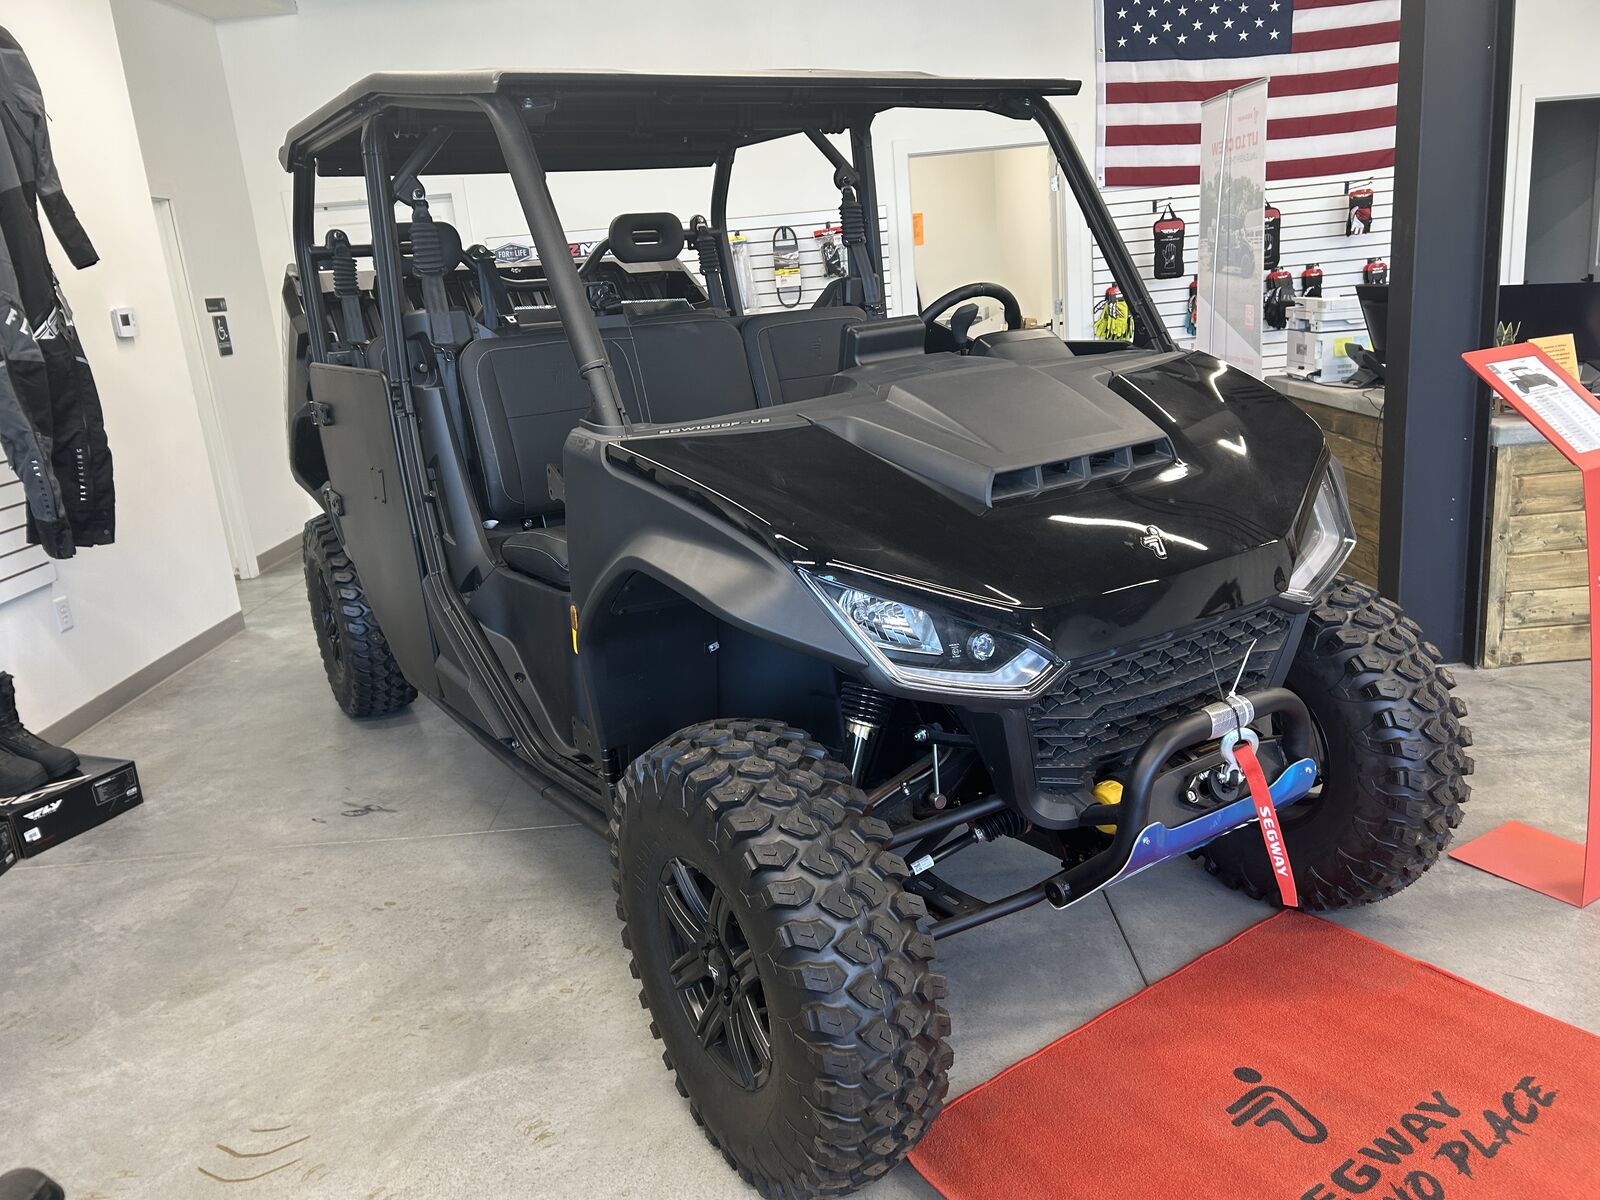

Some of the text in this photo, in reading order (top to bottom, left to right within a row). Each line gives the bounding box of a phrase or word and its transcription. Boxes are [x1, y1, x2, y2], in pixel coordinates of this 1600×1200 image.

[498, 250, 511, 259] FOR
[514, 249, 527, 257] LIFE
[1260, 805, 1288, 877] SEGWAY
[1431, 1076, 1559, 1180] PLACE
